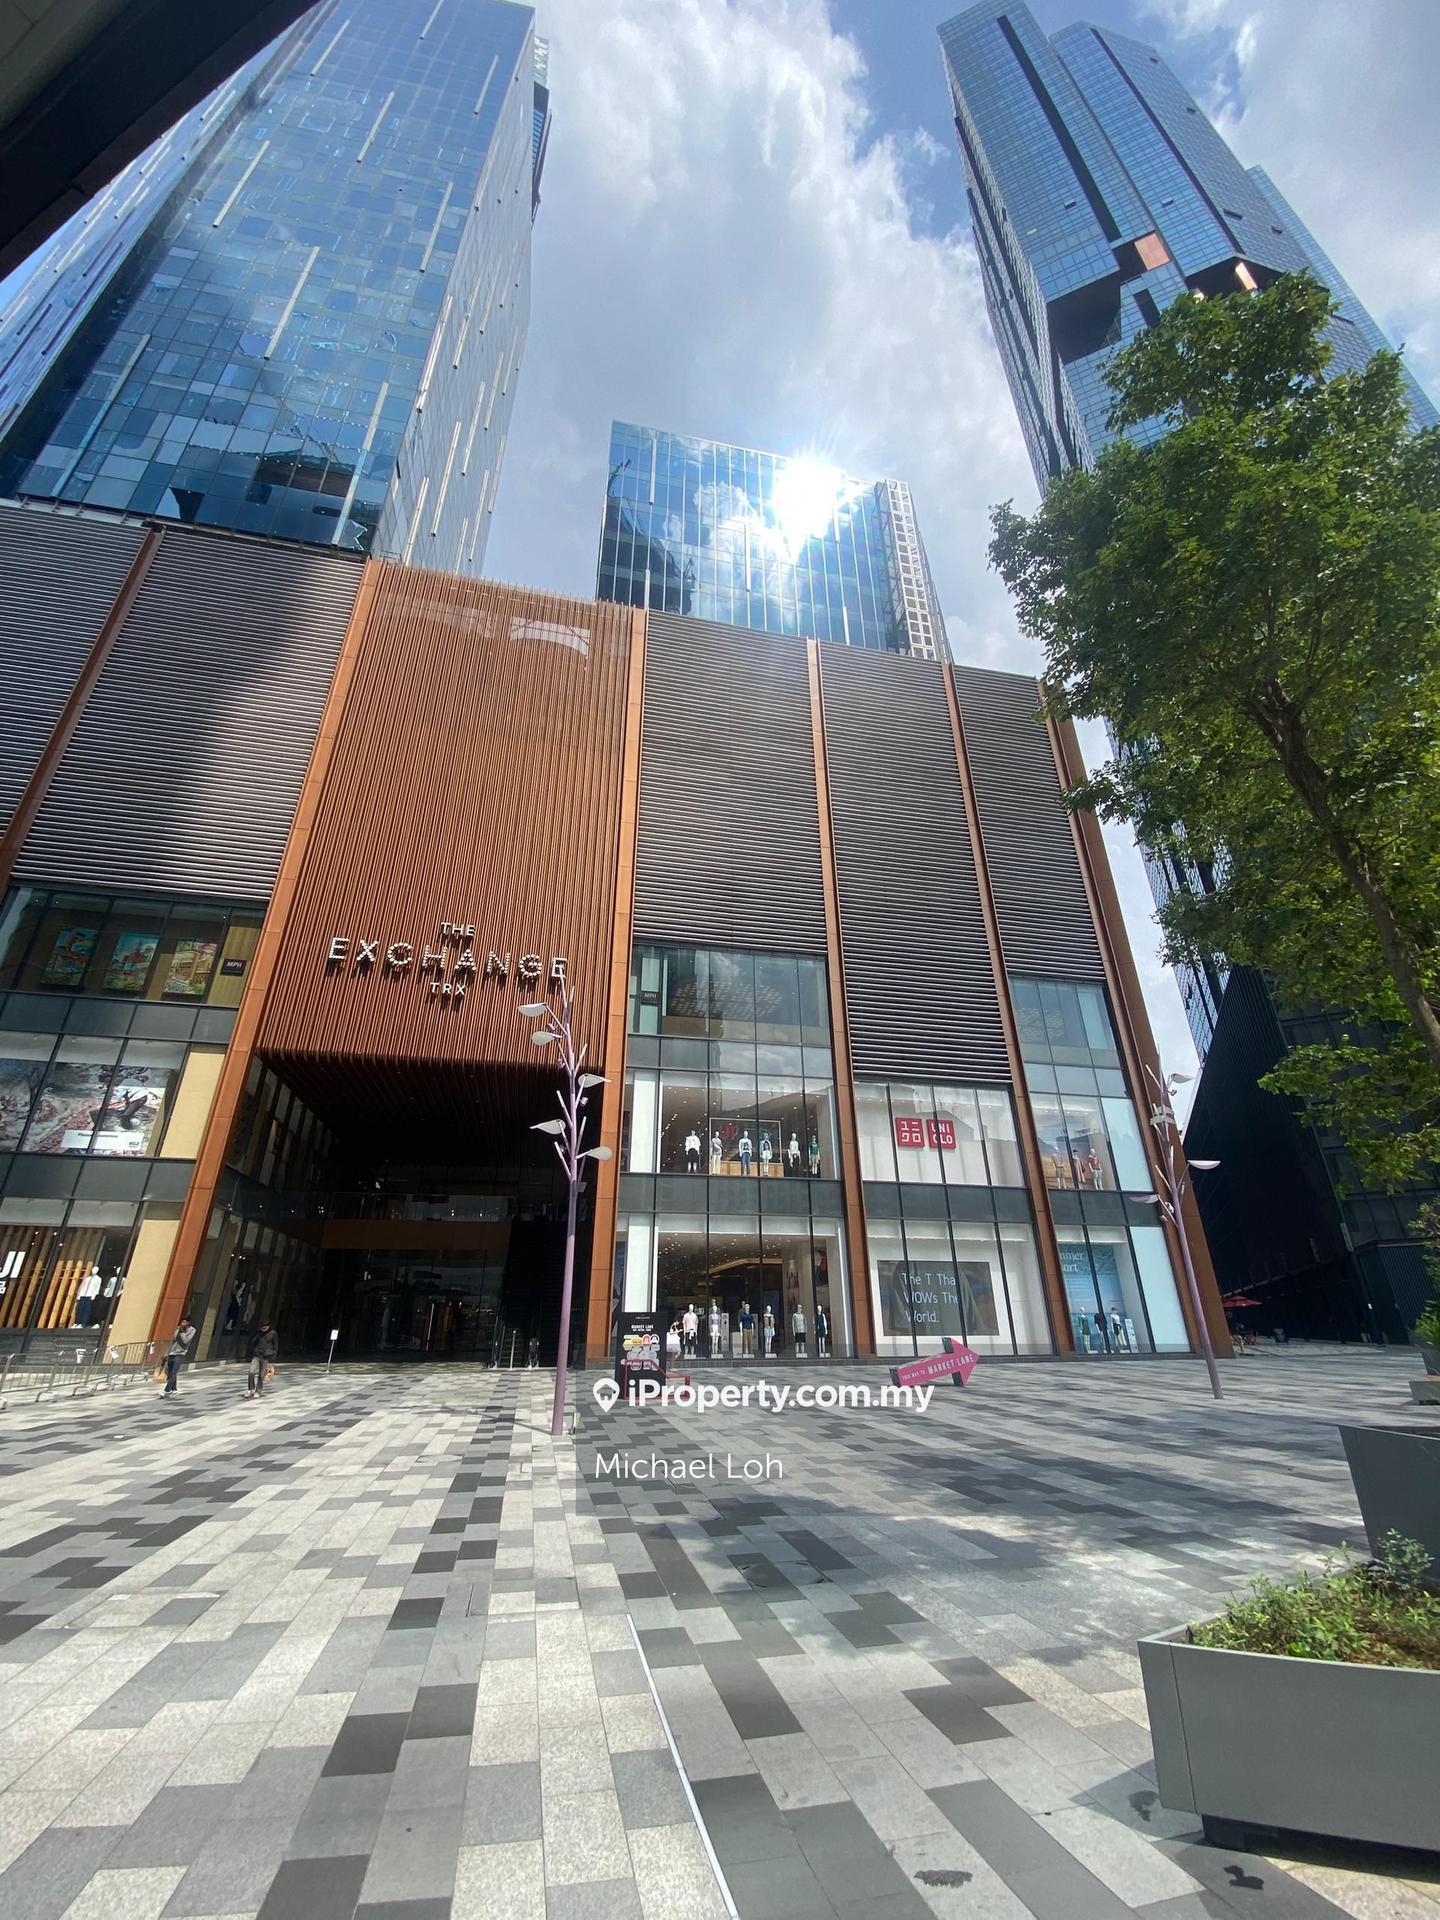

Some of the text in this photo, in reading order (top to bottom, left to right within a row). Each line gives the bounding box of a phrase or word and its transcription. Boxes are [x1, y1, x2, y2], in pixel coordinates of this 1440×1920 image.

[440, 922, 475, 937] THE
[328, 937, 568, 979] EXCHANGE
[430, 982, 466, 996] TRX
[0, 1251, 26, 1279] JI
[901, 1272, 957, 1286] The T Tha
[903, 1290, 938, 1304] WOWs
[905, 1310, 940, 1323] World.
[928, 1360, 955, 1374] MARKET
[957, 1354, 974, 1366] LANE
